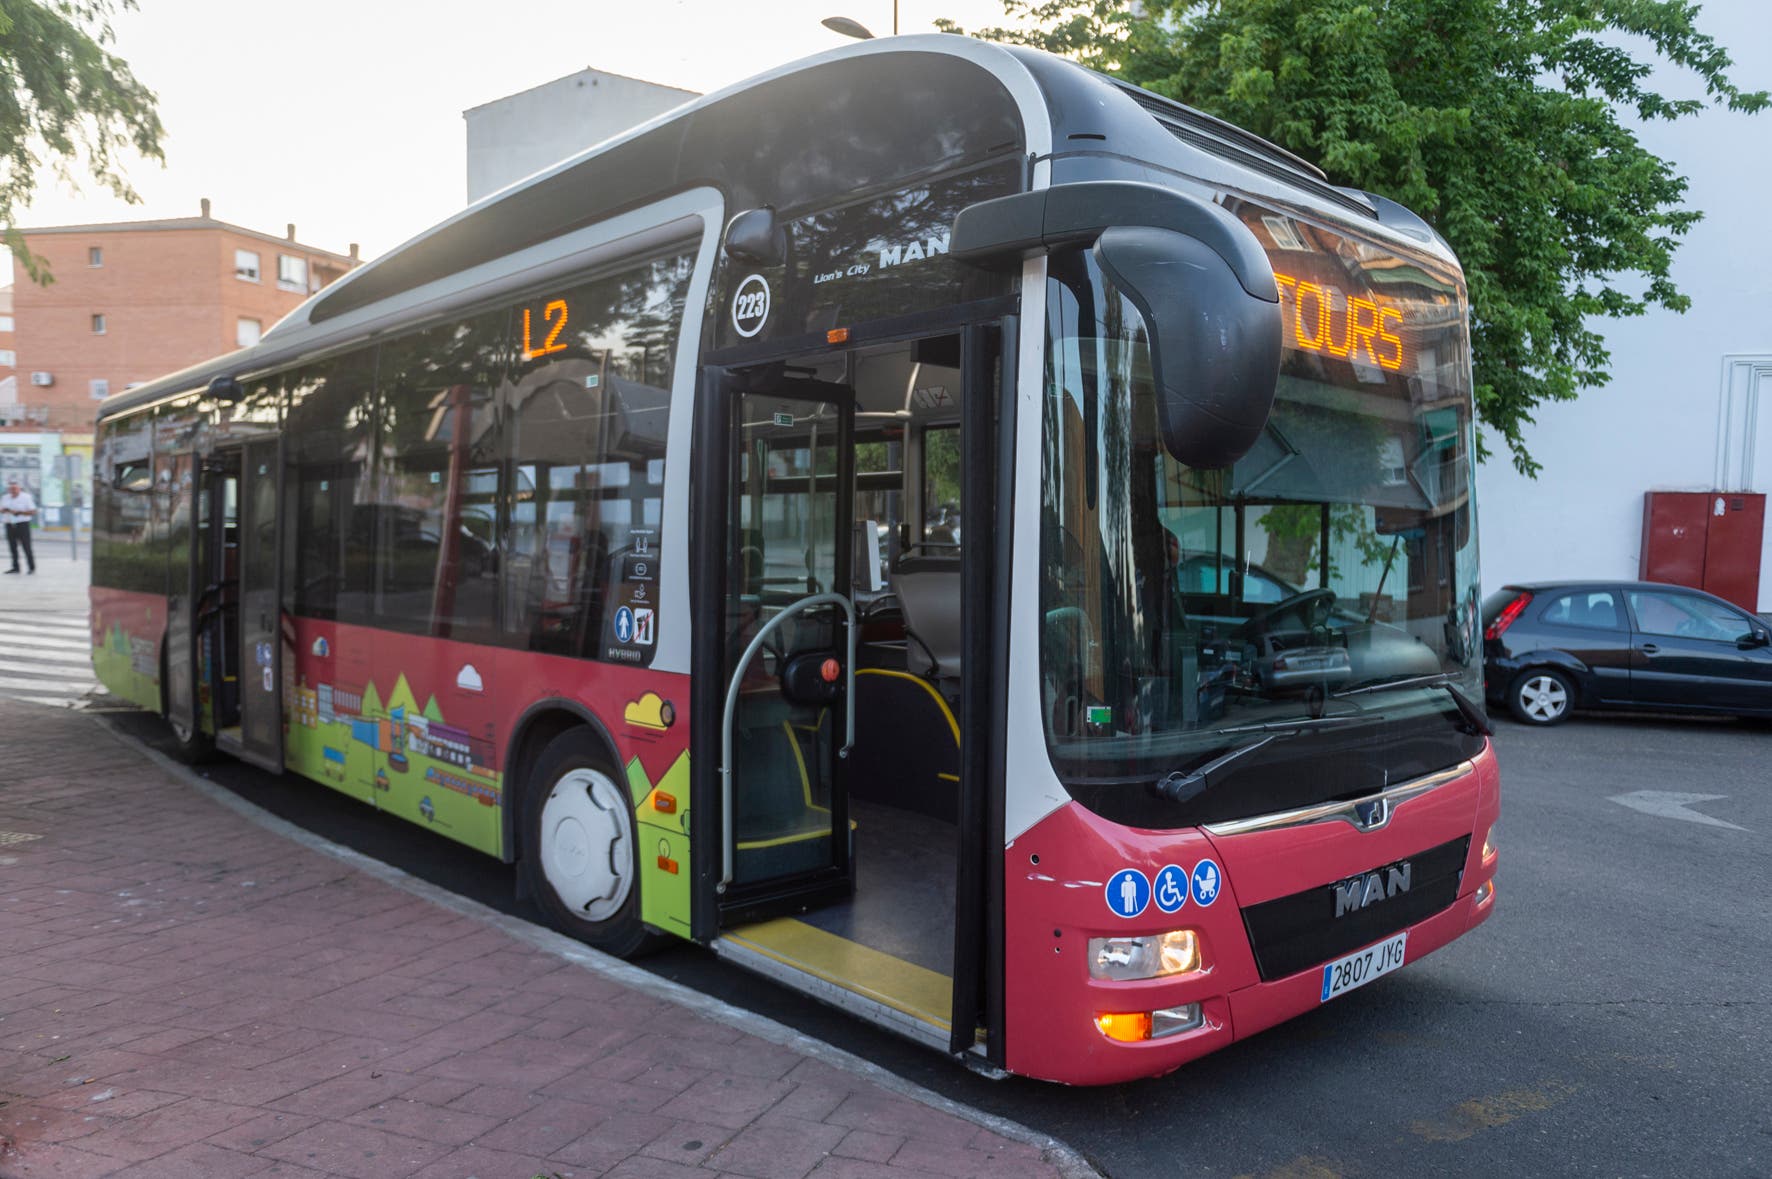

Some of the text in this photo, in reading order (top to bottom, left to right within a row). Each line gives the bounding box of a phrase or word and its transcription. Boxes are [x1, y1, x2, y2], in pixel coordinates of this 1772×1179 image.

[879, 233, 951, 269] MAN
[814, 264, 871, 284] Lion's City
[737, 292, 765, 320] 223
[523, 299, 568, 358] L2
[608, 648, 641, 662] HYBRID
[1334, 863, 1411, 918] MAN
[1332, 939, 1403, 993] 2807 JYG
